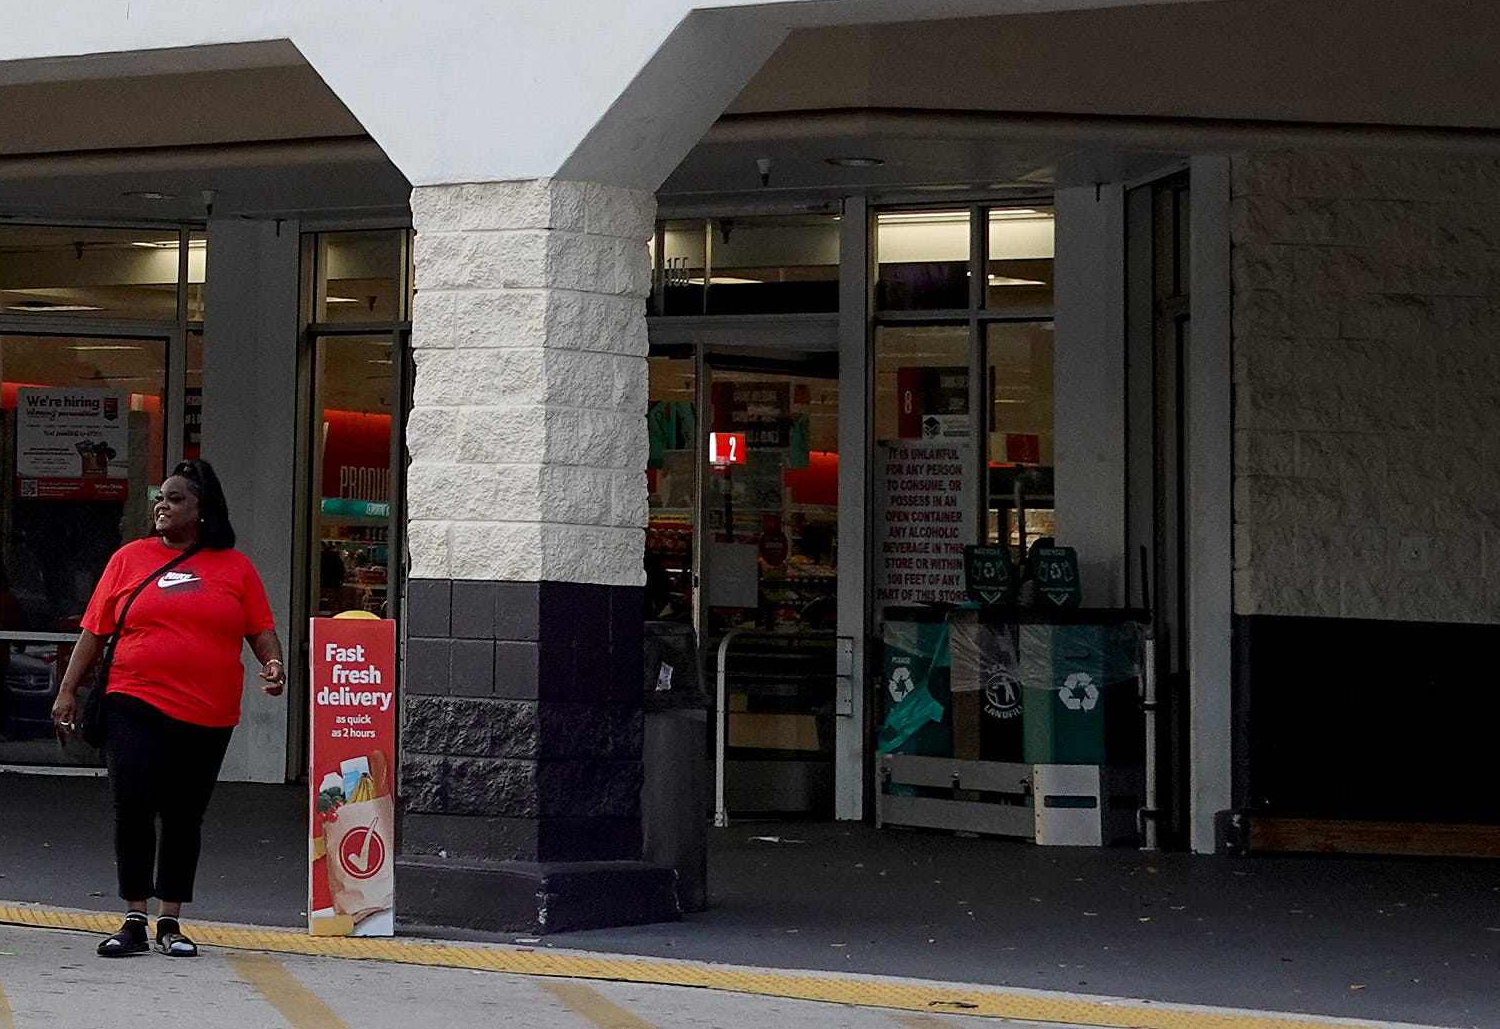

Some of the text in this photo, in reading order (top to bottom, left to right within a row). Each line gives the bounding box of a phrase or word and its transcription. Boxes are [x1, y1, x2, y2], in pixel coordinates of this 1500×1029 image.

[27, 396, 62, 407] We're
[64, 396, 100, 410] hiring
[728, 436, 737, 461] 2
[911, 447, 959, 460] UNLAWFUL
[886, 464, 962, 475] FOR ANY PERSON
[339, 464, 390, 501] PRODU
[887, 480, 898, 491] TO
[948, 480, 962, 491] OR
[890, 496, 957, 507] POSSESS IN AN
[885, 511, 962, 522] OPEN CONTAINER
[888, 527, 958, 538] ANY ALCOHOLIC
[883, 542, 965, 553] BEVERAGE IN THIS
[884, 558, 962, 569] STORE OR WITHIN
[888, 574, 960, 585] 100 FEET OF ANY
[877, 589, 968, 600] PART OF THIS STORE
[325, 643, 366, 662] Fast
[332, 664, 382, 684] fresh
[317, 686, 393, 711] delivery
[336, 714, 372, 725] as quick
[331, 728, 376, 738] as 2 hours
